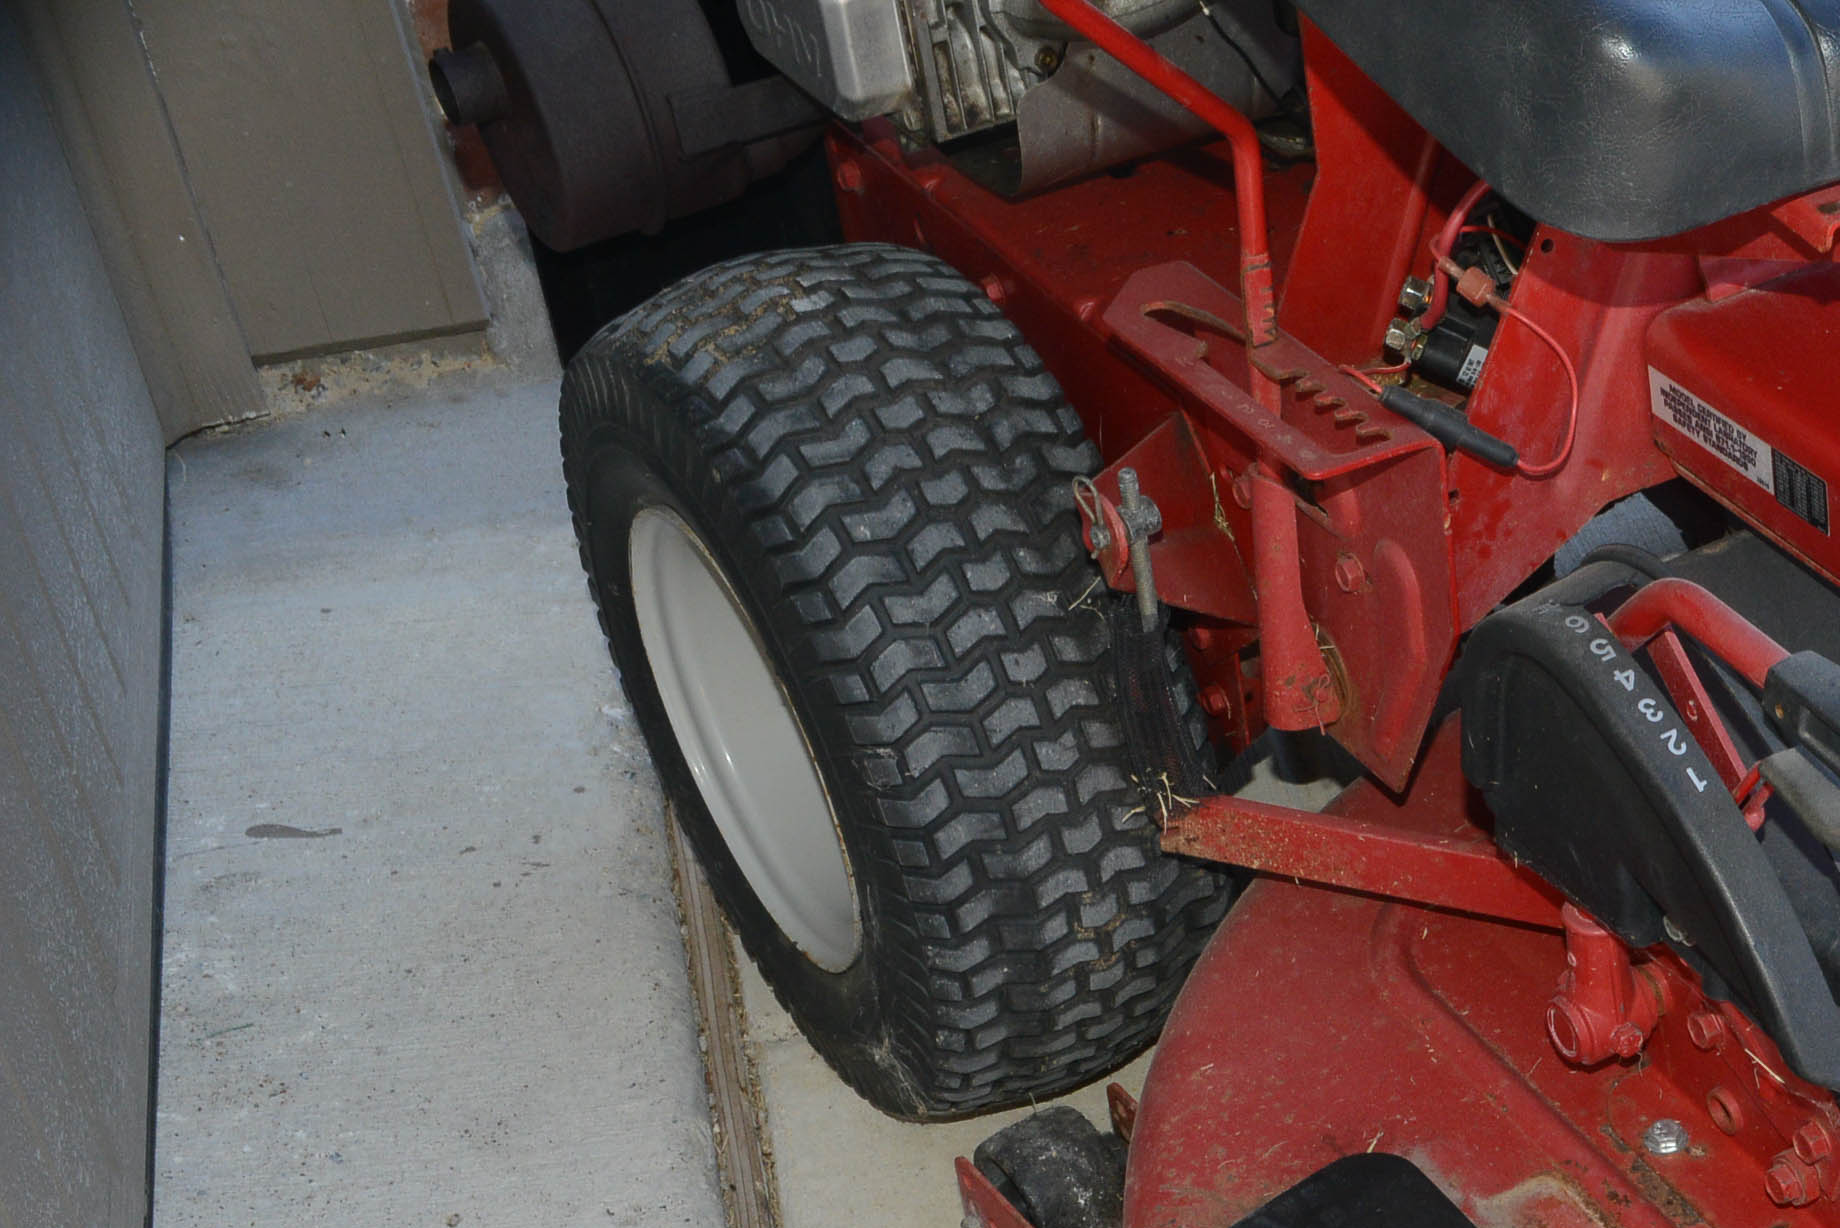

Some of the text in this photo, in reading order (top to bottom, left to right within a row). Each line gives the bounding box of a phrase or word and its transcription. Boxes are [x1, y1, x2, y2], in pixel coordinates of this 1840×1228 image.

[1659, 386, 1711, 428] INDEPENDENT
[1668, 382, 1747, 443] MODEL CERTIFIED BY
[1672, 412, 1748, 472] SAFETY STANDARDS
[1565, 615, 1708, 793] 1 2 3 4 5 6
